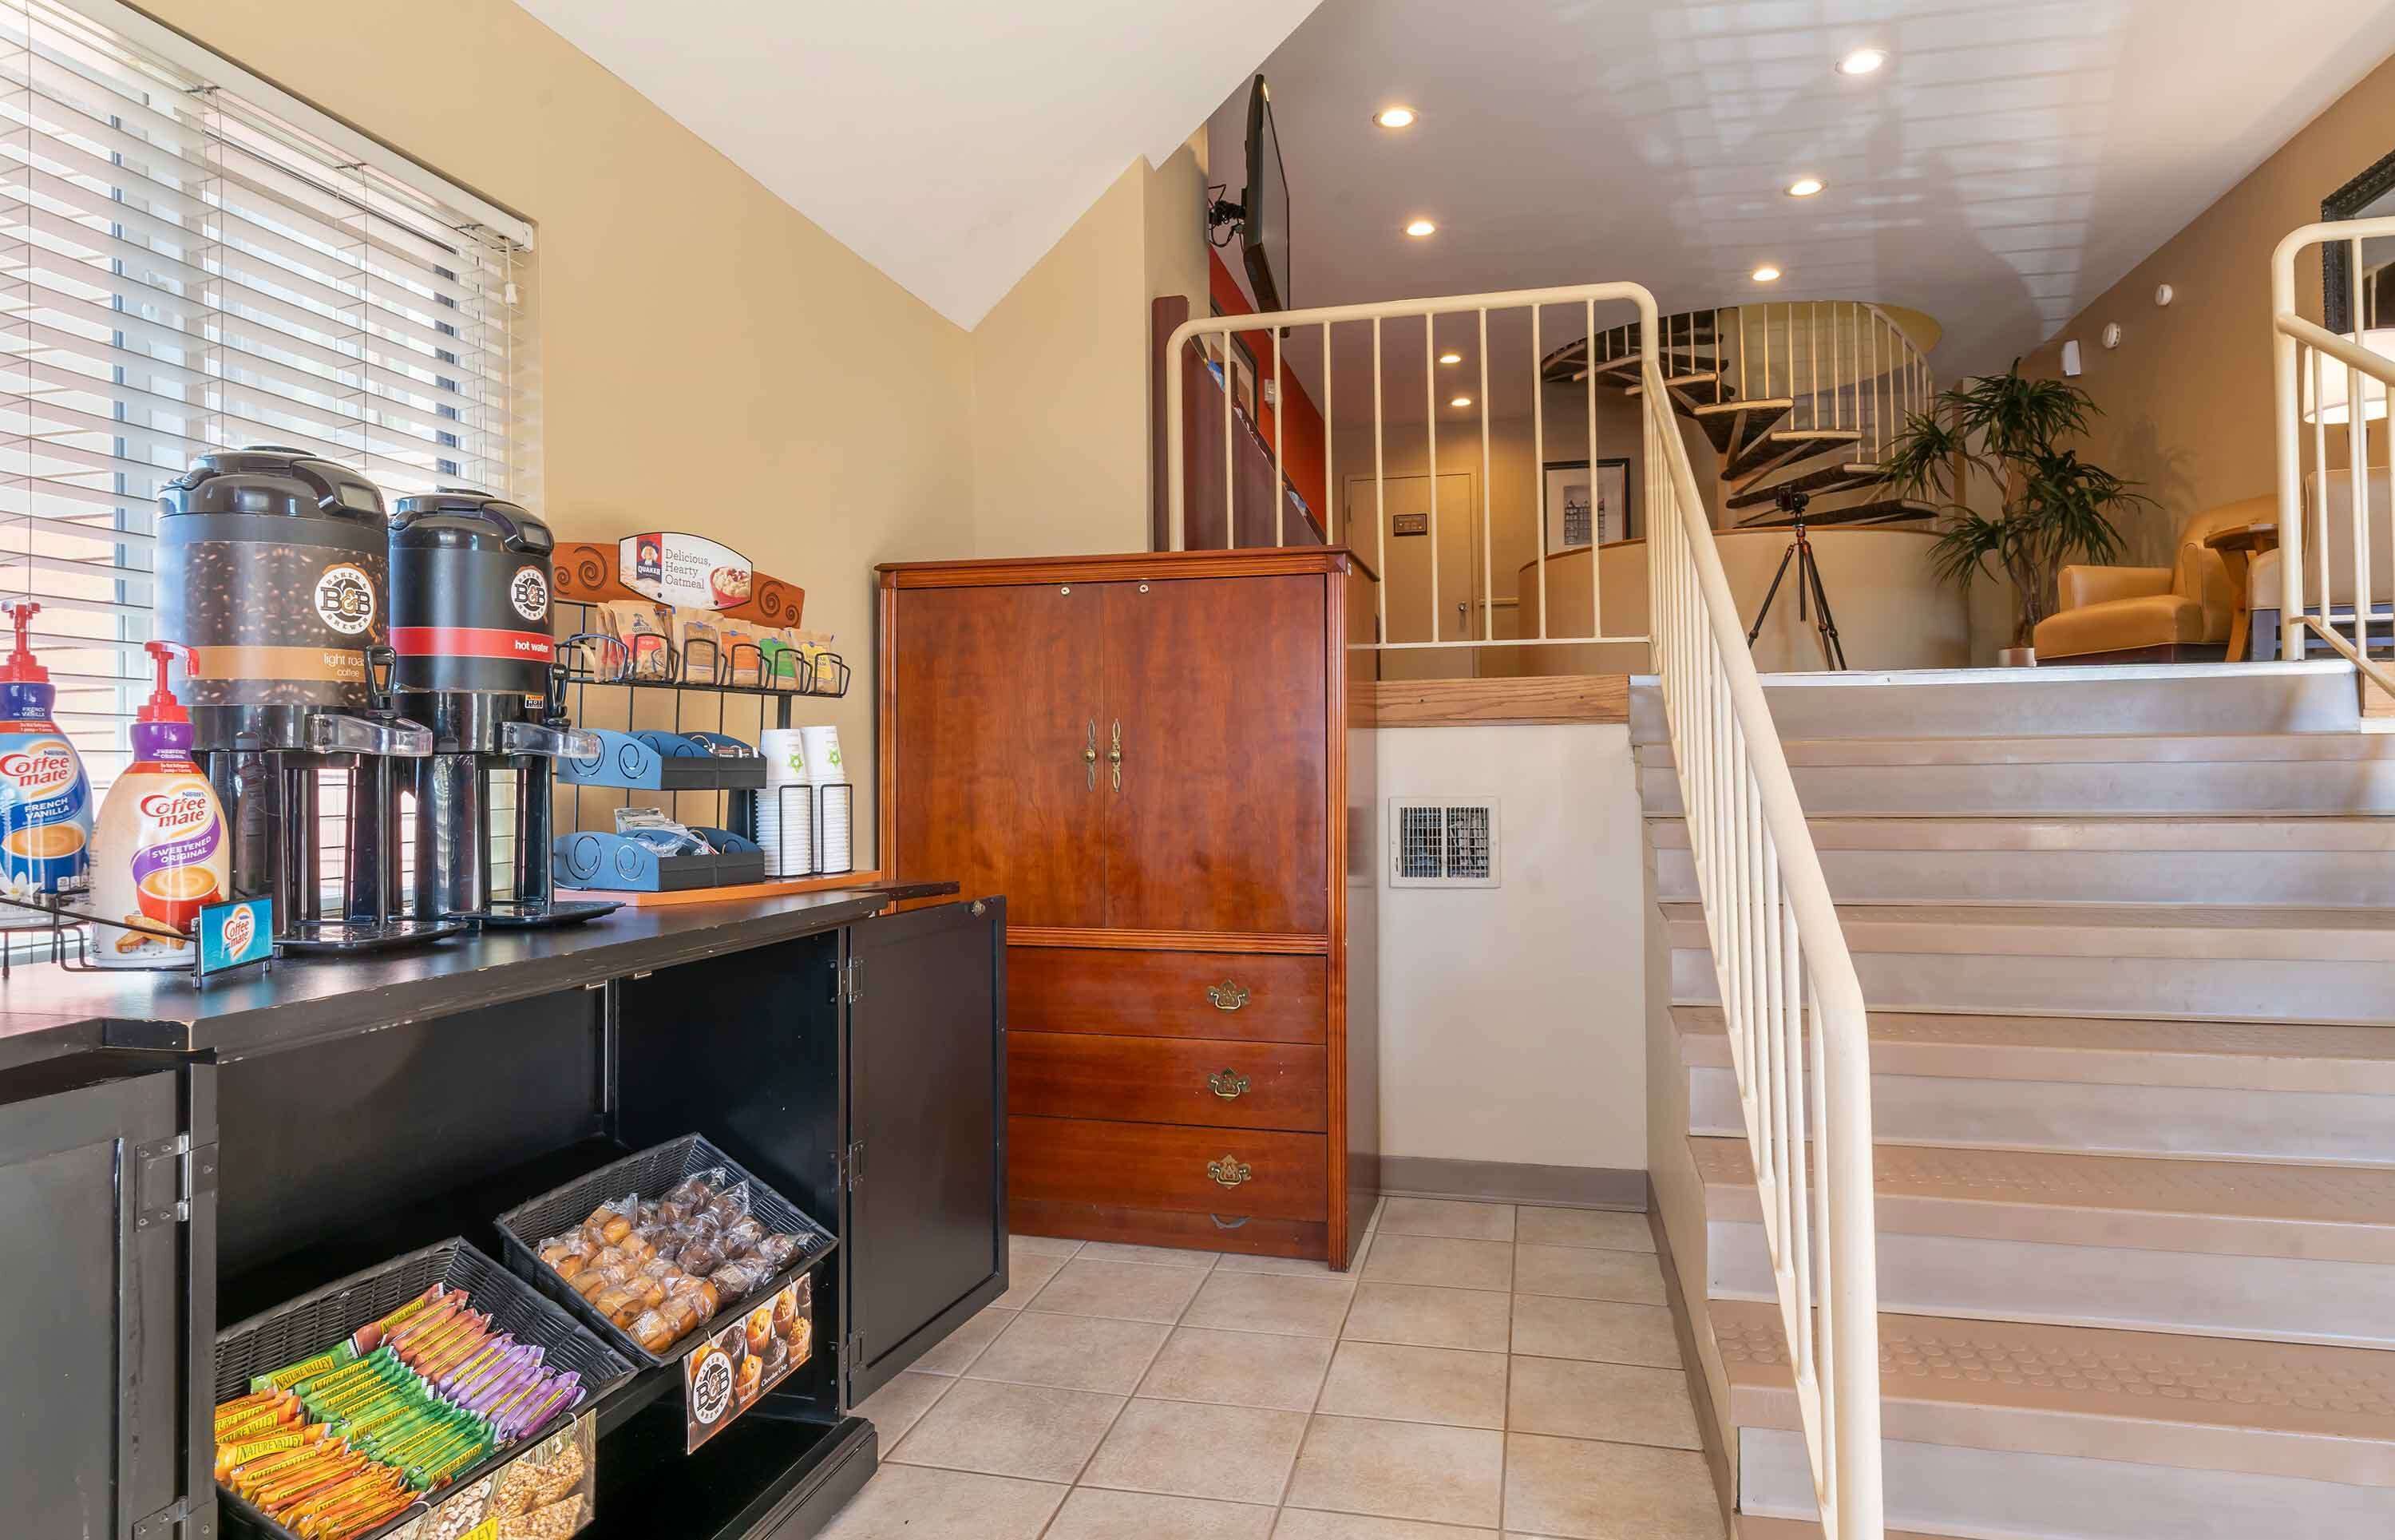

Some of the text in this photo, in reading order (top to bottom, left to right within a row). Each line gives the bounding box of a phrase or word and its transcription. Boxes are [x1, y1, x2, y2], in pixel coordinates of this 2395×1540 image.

[665, 548, 711, 567] Delicious,
[638, 565, 660, 576] QUAKER
[665, 561, 699, 579] Hearty
[665, 574, 705, 589] Oatmeal
[320, 586, 371, 616] B&B
[515, 583, 546, 606] B&B
[515, 639, 549, 653] hot water
[323, 652, 365, 667] light roa
[337, 667, 359, 677] coffee
[0, 754, 70, 777] Coffee
[19, 769, 68, 787] mate
[25, 797, 69, 814] FRENCH
[26, 805, 69, 821] VANILLA
[140, 794, 206, 818] Coffee
[158, 810, 204, 828] mate
[152, 835, 212, 859] SWEETENED
[161, 847, 208, 864] ORIGINAL
[224, 920, 250, 940] Coffee
[231, 930, 250, 948] mate
[275, 1369, 303, 1389] NATURE
[303, 1357, 333, 1375] VALLEY
[696, 1367, 730, 1411] B&B
[215, 1418, 236, 1432] TURE
[248, 1413, 277, 1435] VALLEY
[242, 1435, 303, 1459] NATURE VALLEY
